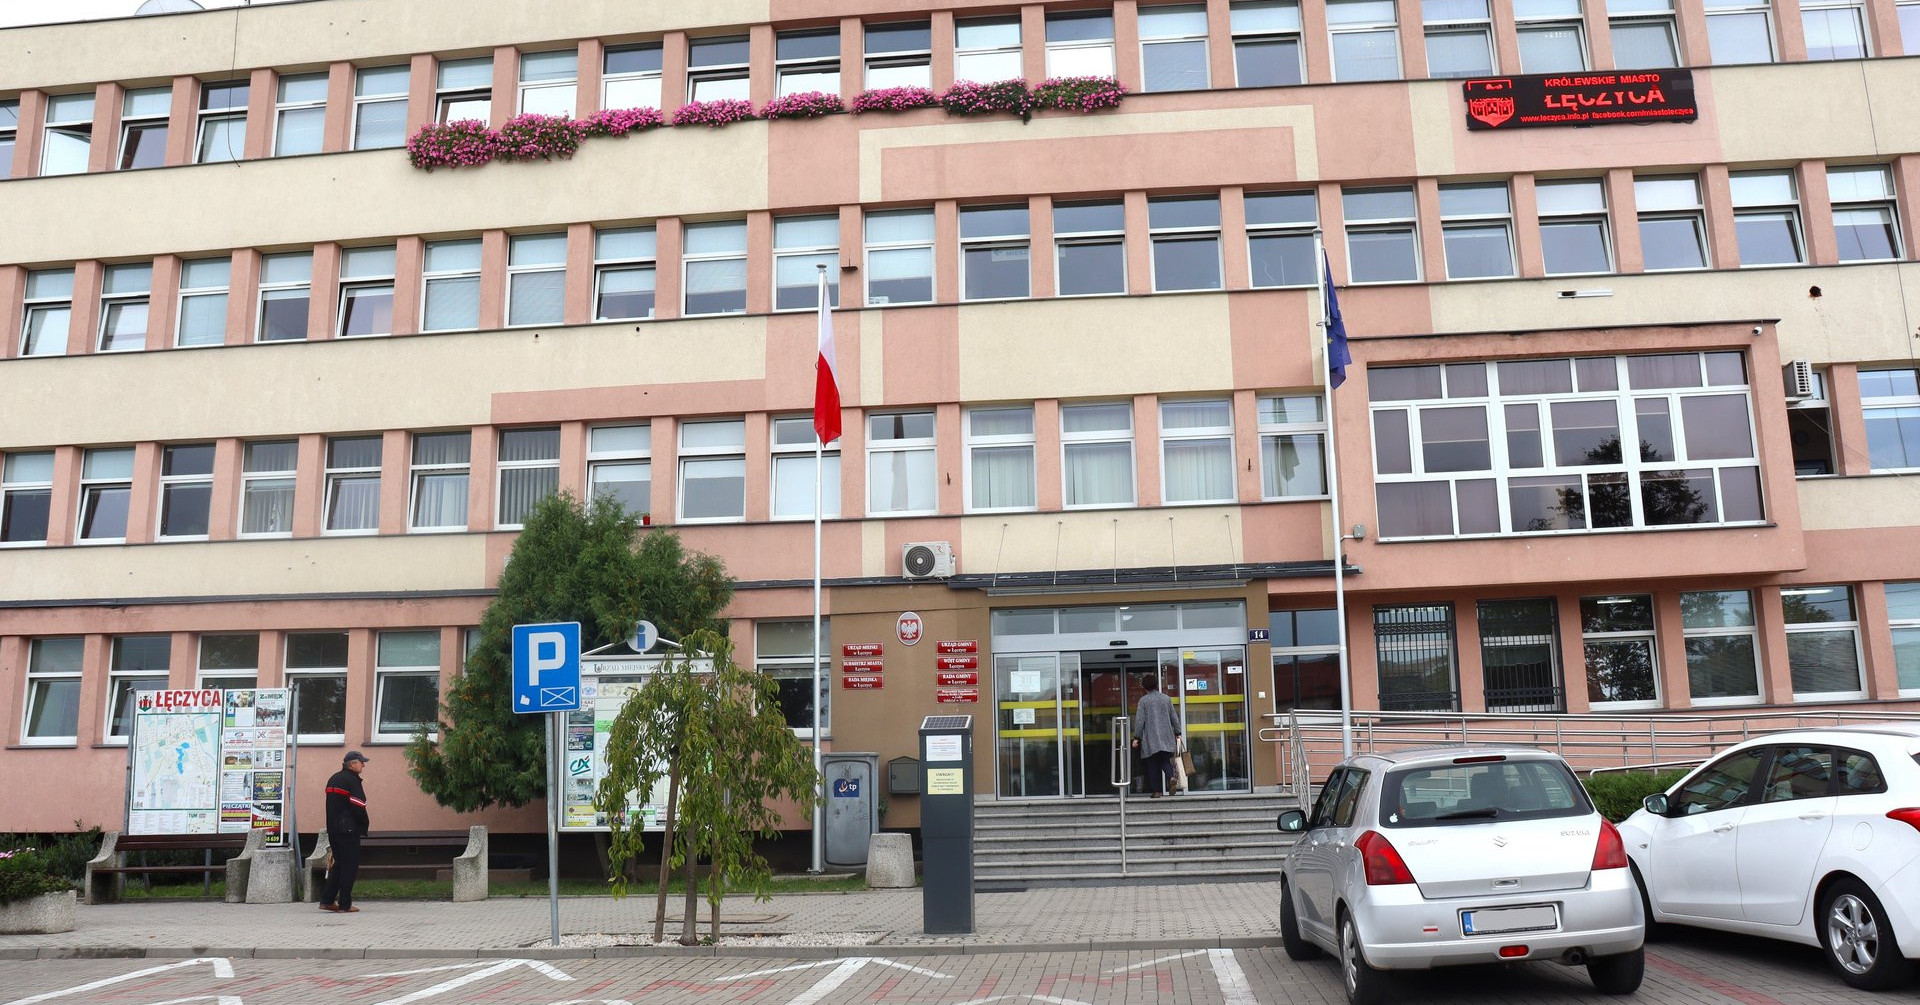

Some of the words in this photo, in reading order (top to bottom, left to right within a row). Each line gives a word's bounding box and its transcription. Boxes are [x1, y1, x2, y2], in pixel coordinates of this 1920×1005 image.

[1544, 76, 1616, 87] KRÓLEWSKIE
[1620, 74, 1660, 84] MIASTO
[1254, 630, 1264, 639] 14
[528, 631, 566, 687] P
[155, 690, 222, 712] ŁĘCZYCA
[848, 783, 857, 791] tp
